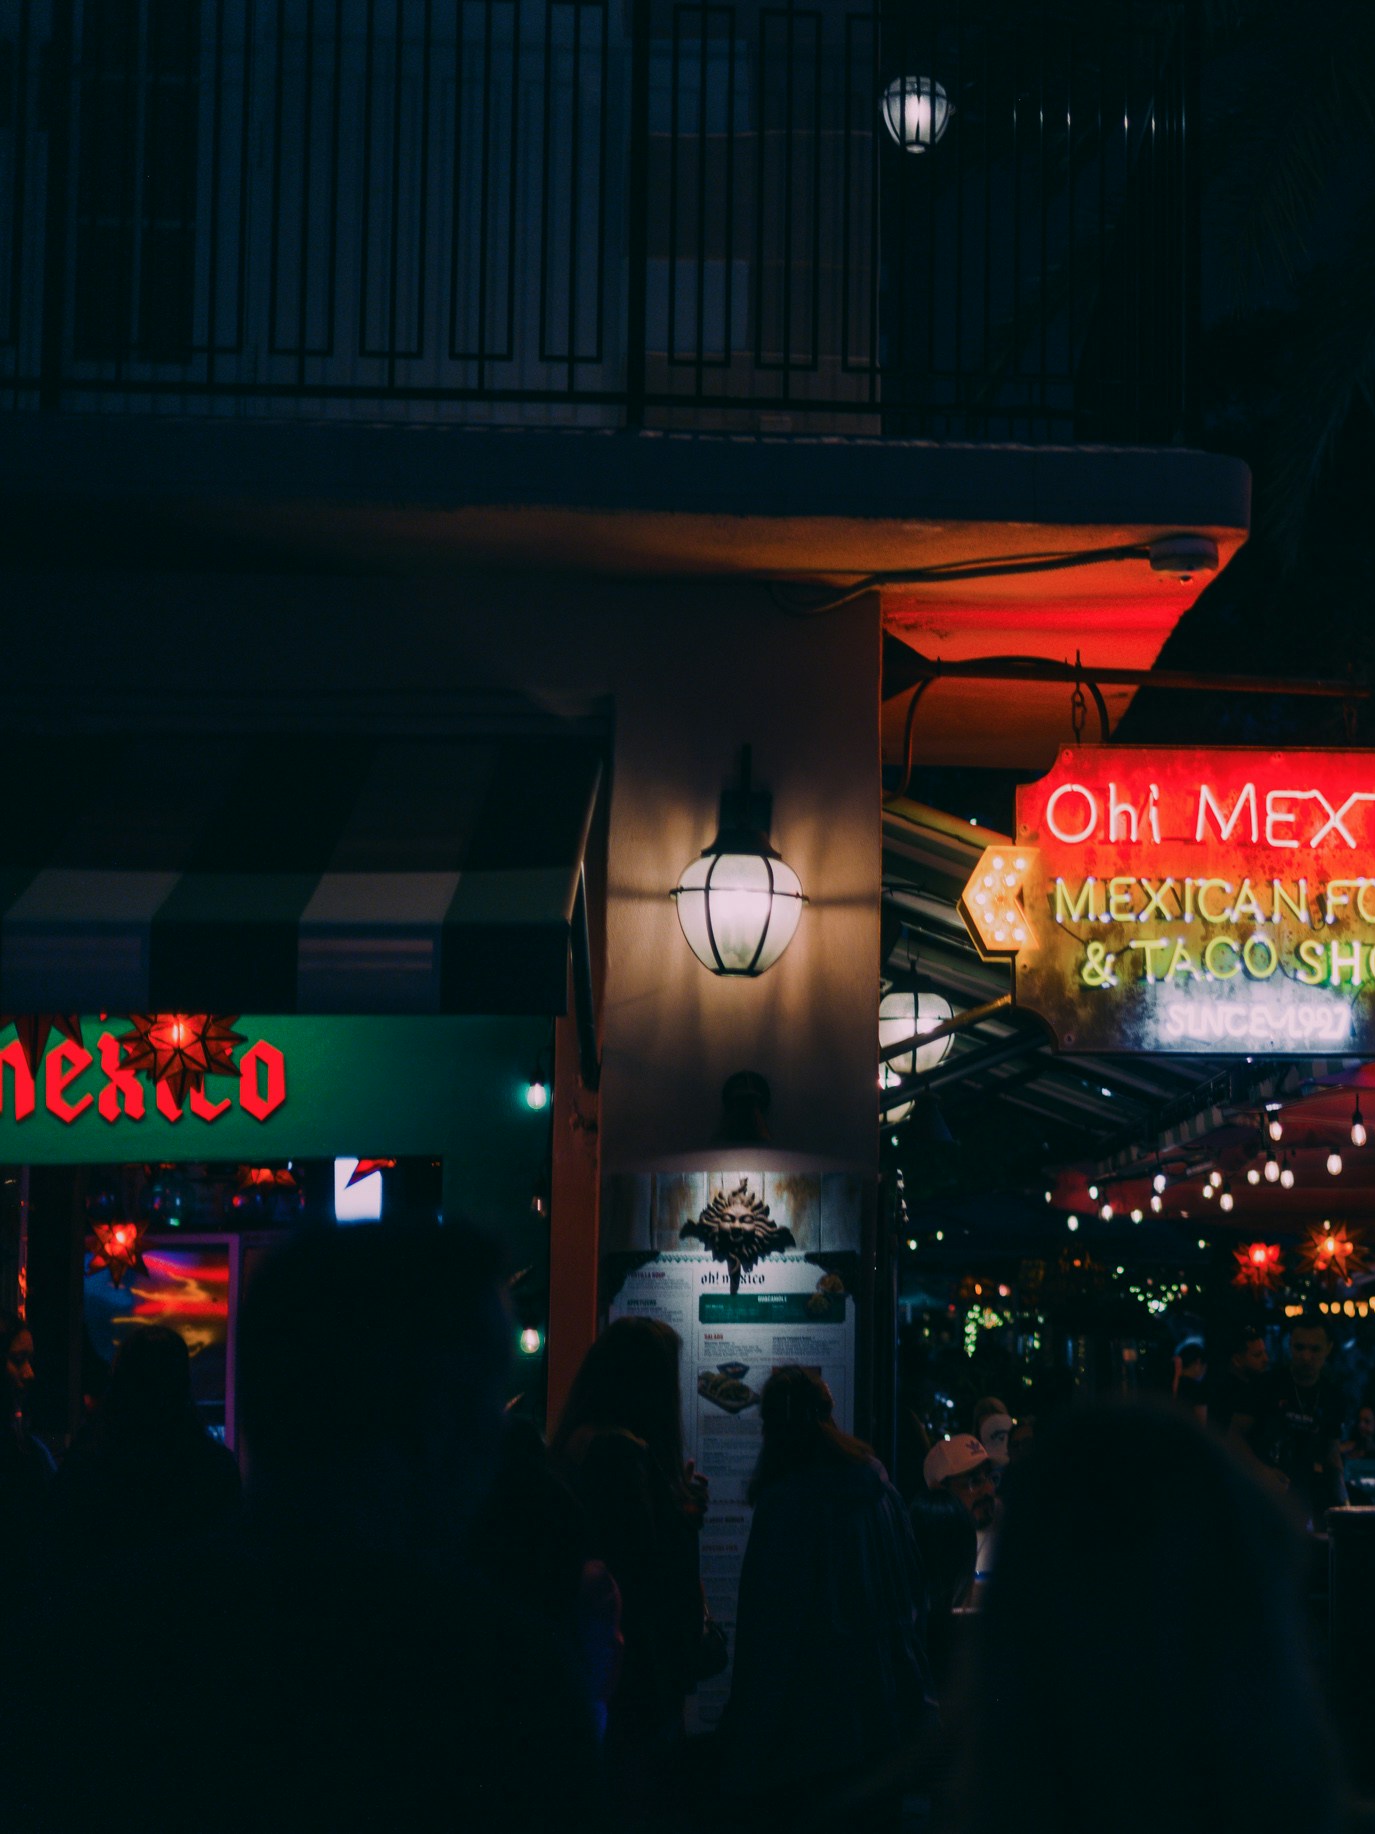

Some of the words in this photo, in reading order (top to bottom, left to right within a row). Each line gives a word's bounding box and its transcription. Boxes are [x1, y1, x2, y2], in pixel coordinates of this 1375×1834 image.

[1054, 876, 1308, 924] MEXICAN
[1081, 941, 1119, 987] &
[1130, 931, 1279, 983] TACO
[1166, 1004, 1268, 1037] SINCE
